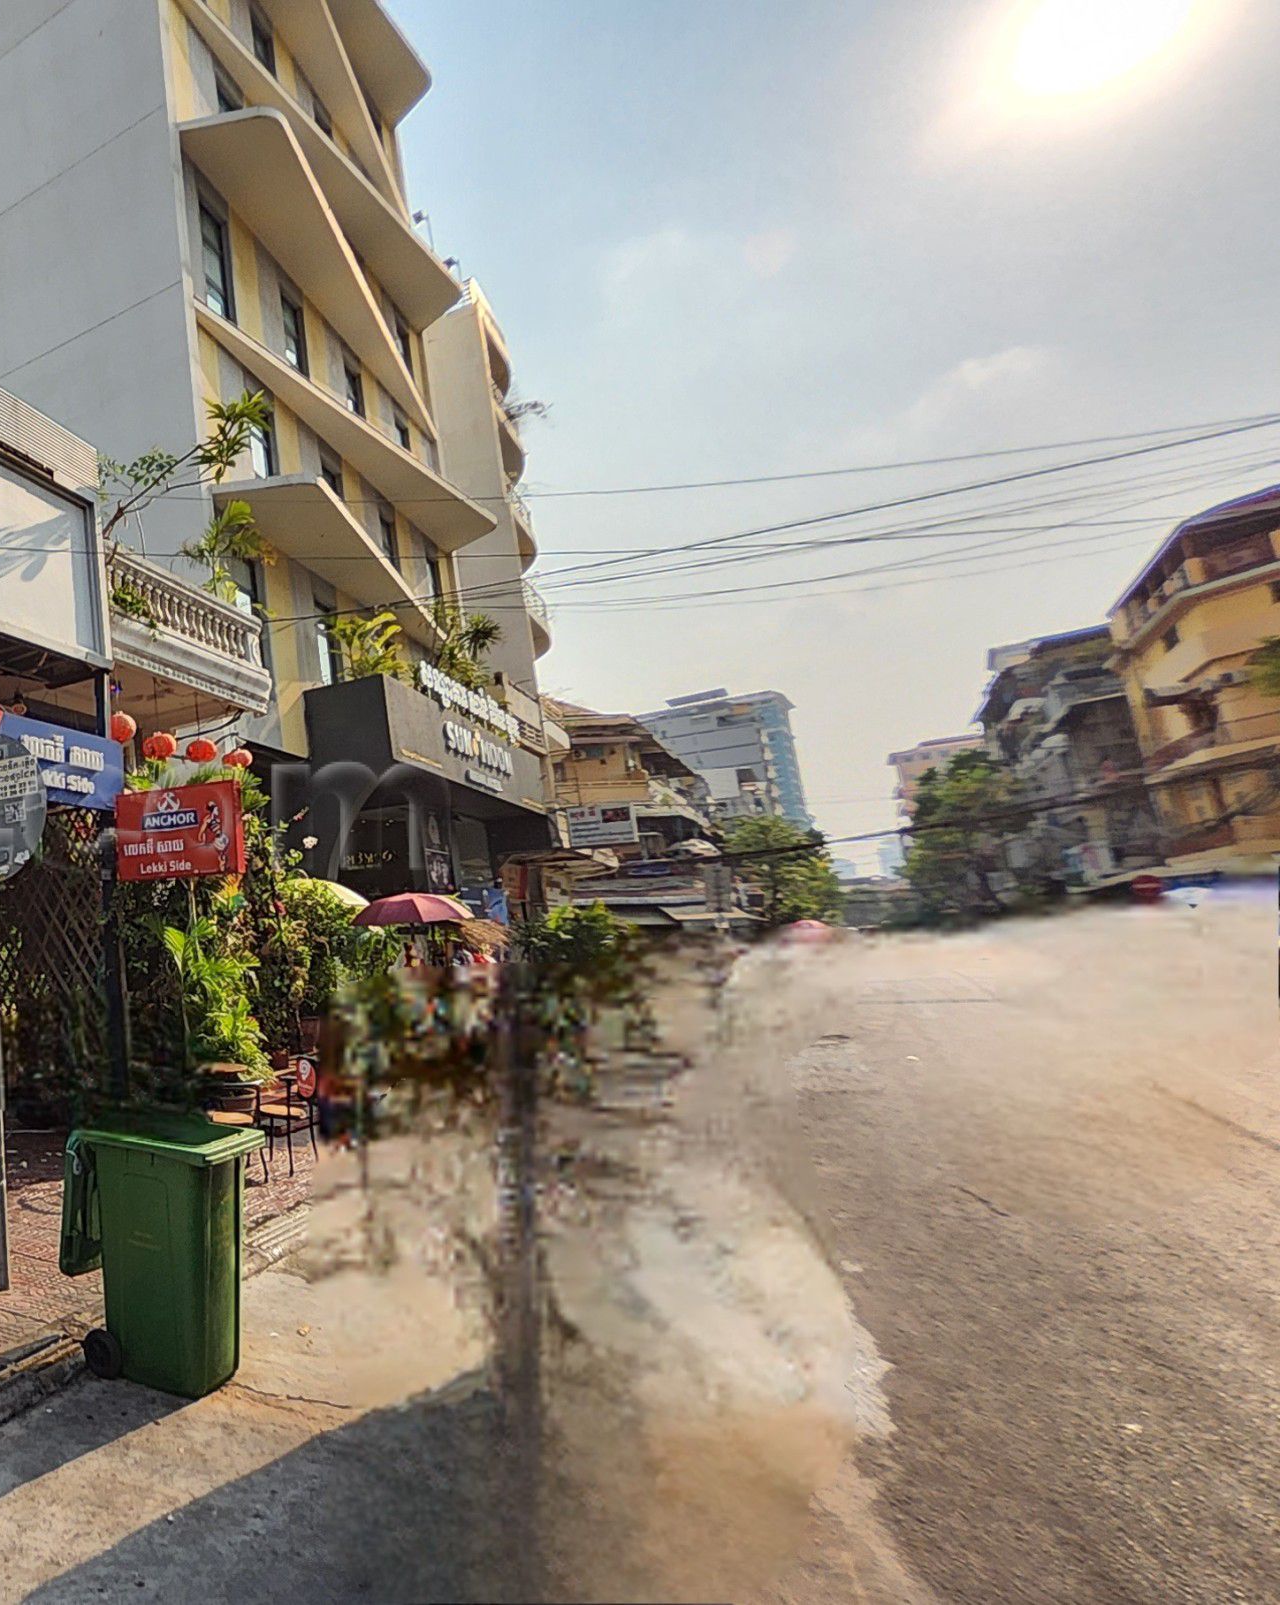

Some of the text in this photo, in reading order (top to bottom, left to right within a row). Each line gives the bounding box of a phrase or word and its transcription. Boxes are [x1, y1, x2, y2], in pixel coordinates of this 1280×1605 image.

[443, 721, 474, 757] SUN
[143, 811, 196, 829] ANCHOR
[140, 860, 192, 874] Lekki Side
